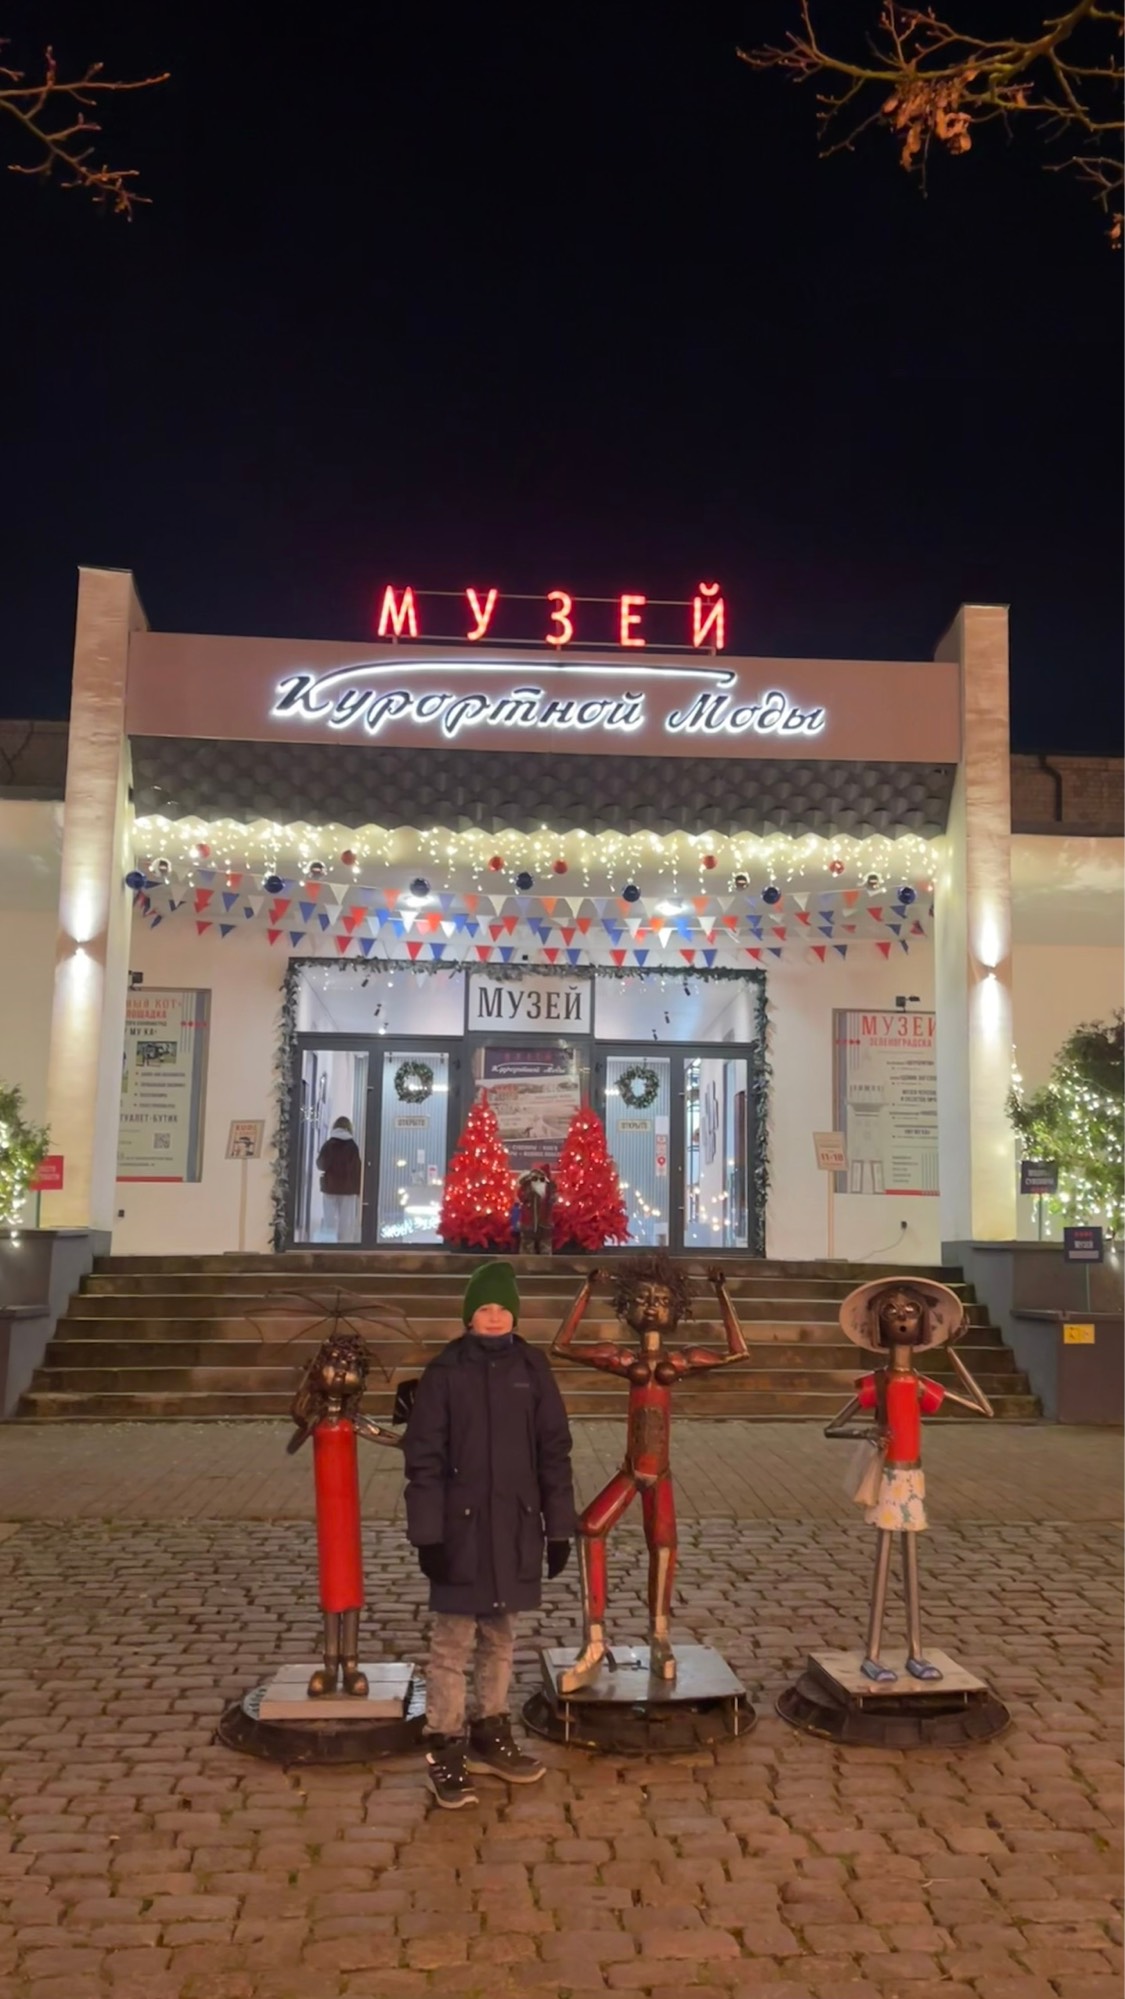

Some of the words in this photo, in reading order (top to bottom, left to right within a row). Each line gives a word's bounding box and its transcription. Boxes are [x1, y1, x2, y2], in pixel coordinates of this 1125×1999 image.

[377, 582, 724, 649] МУЗЕЙ
[273, 660, 644, 736] Курортной
[665, 689, 828, 735] Моды
[477, 985, 582, 1021] МУЗЕЙ
